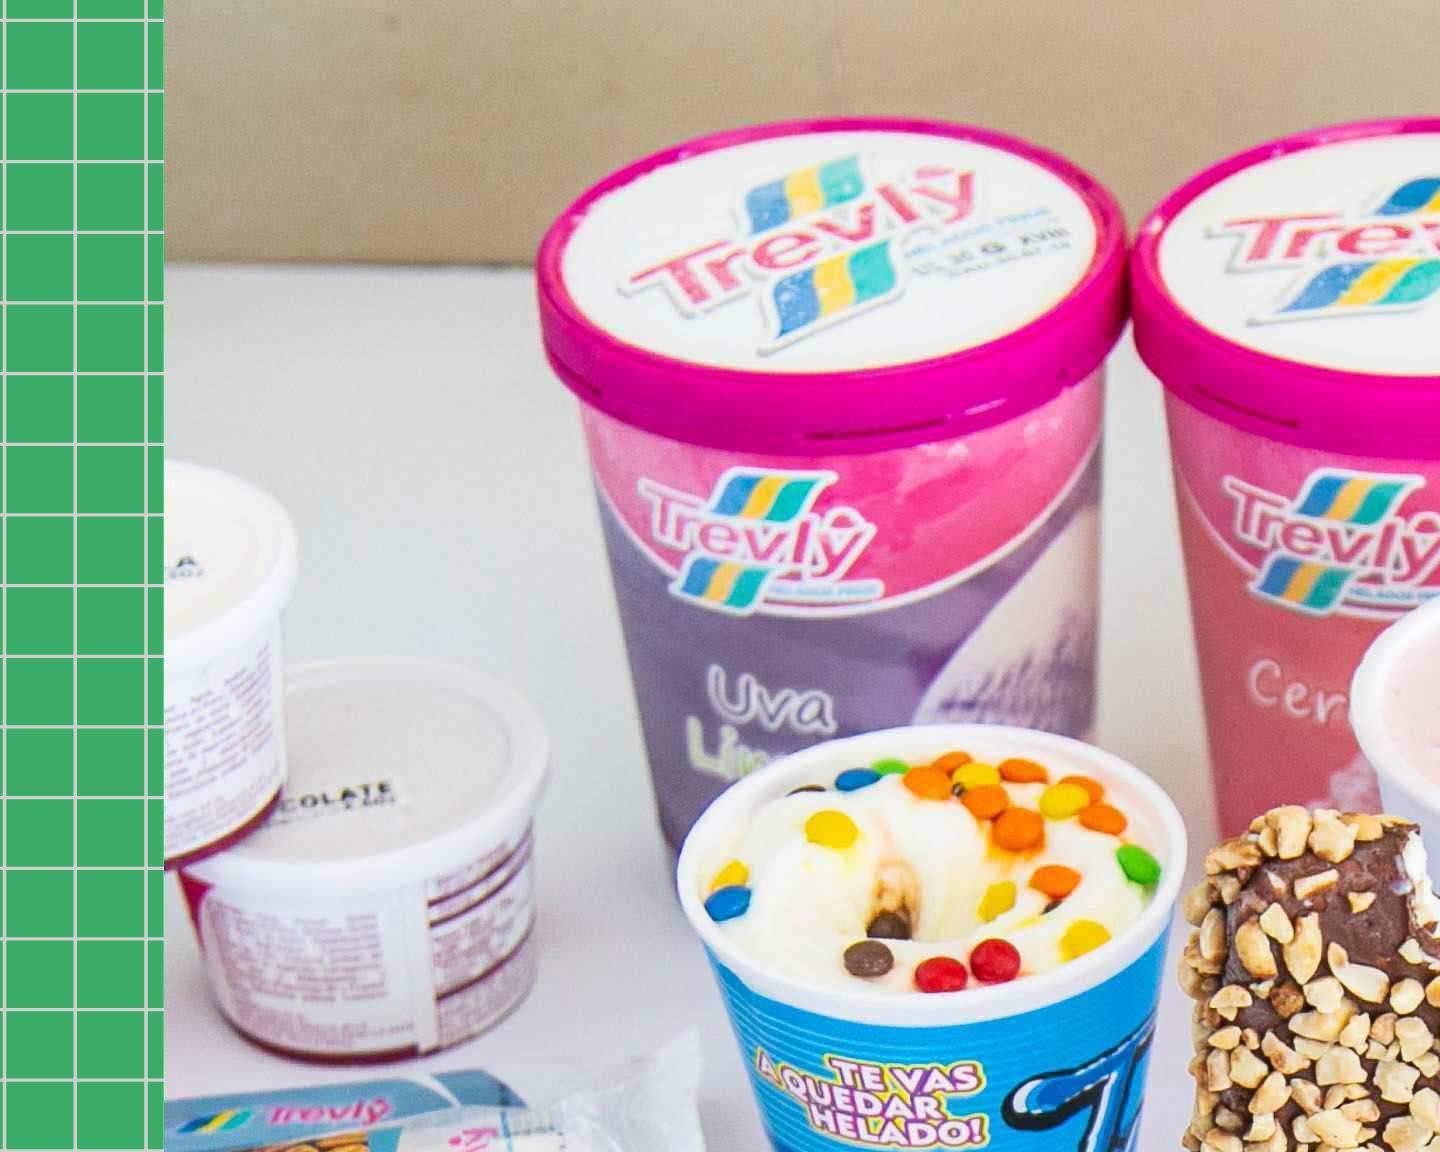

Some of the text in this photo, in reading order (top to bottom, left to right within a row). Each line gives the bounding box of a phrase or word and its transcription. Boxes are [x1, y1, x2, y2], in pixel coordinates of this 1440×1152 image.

[630, 165, 977, 306] Trevly
[642, 481, 873, 579] Trevly
[707, 664, 838, 735] Uva
[755, 1048, 945, 1122] A QUEDAR
[828, 1056, 983, 1096] TE VAS
[808, 1104, 986, 1148] HELADO!
